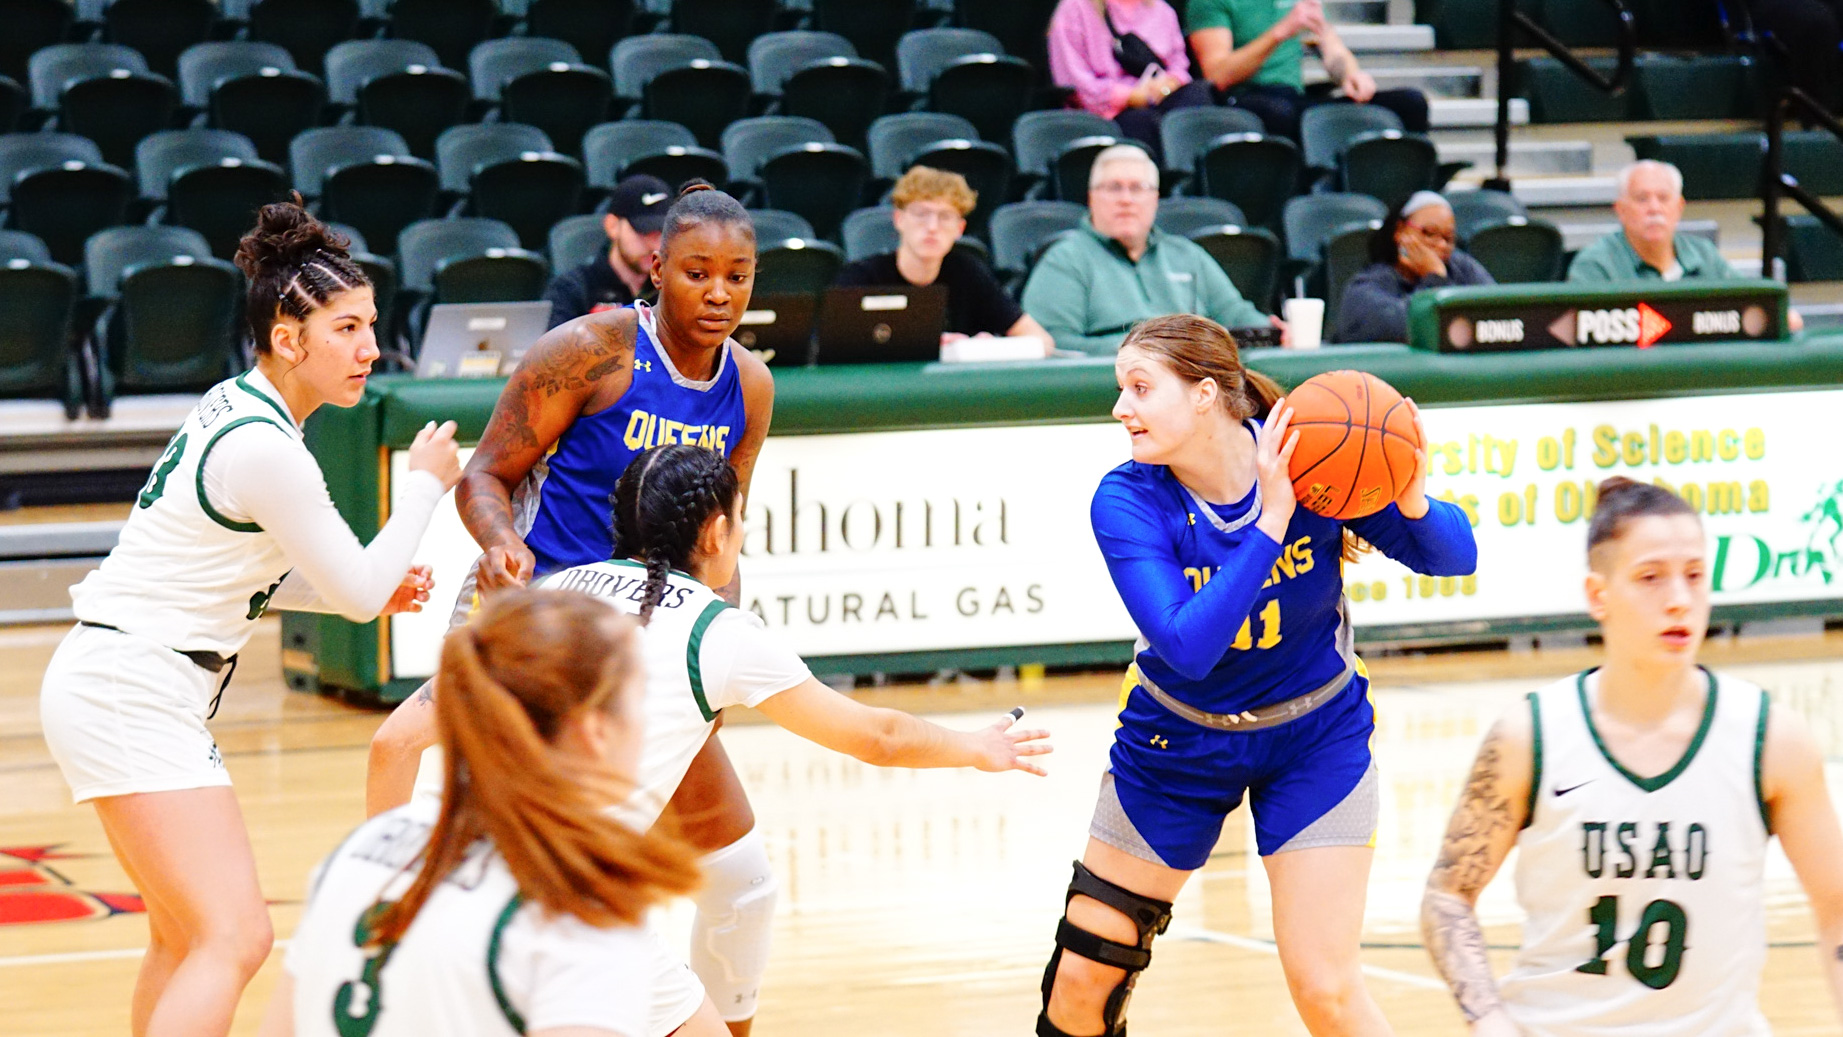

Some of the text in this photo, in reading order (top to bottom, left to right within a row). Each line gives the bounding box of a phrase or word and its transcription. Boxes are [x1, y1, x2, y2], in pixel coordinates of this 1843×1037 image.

[1475, 319, 1524, 343] BONUS
[1577, 308, 1640, 344] POSS
[1692, 311, 1740, 334] BONUS
[623, 409, 730, 457] QUEENS
[1426, 423, 1766, 479] rsity of Science
[741, 468, 1009, 556] ahoma
[1498, 483, 1538, 527] of
[750, 583, 1045, 627] ATURAL GAS
[1580, 822, 1708, 880] USAO
[1575, 895, 1688, 990] 10
